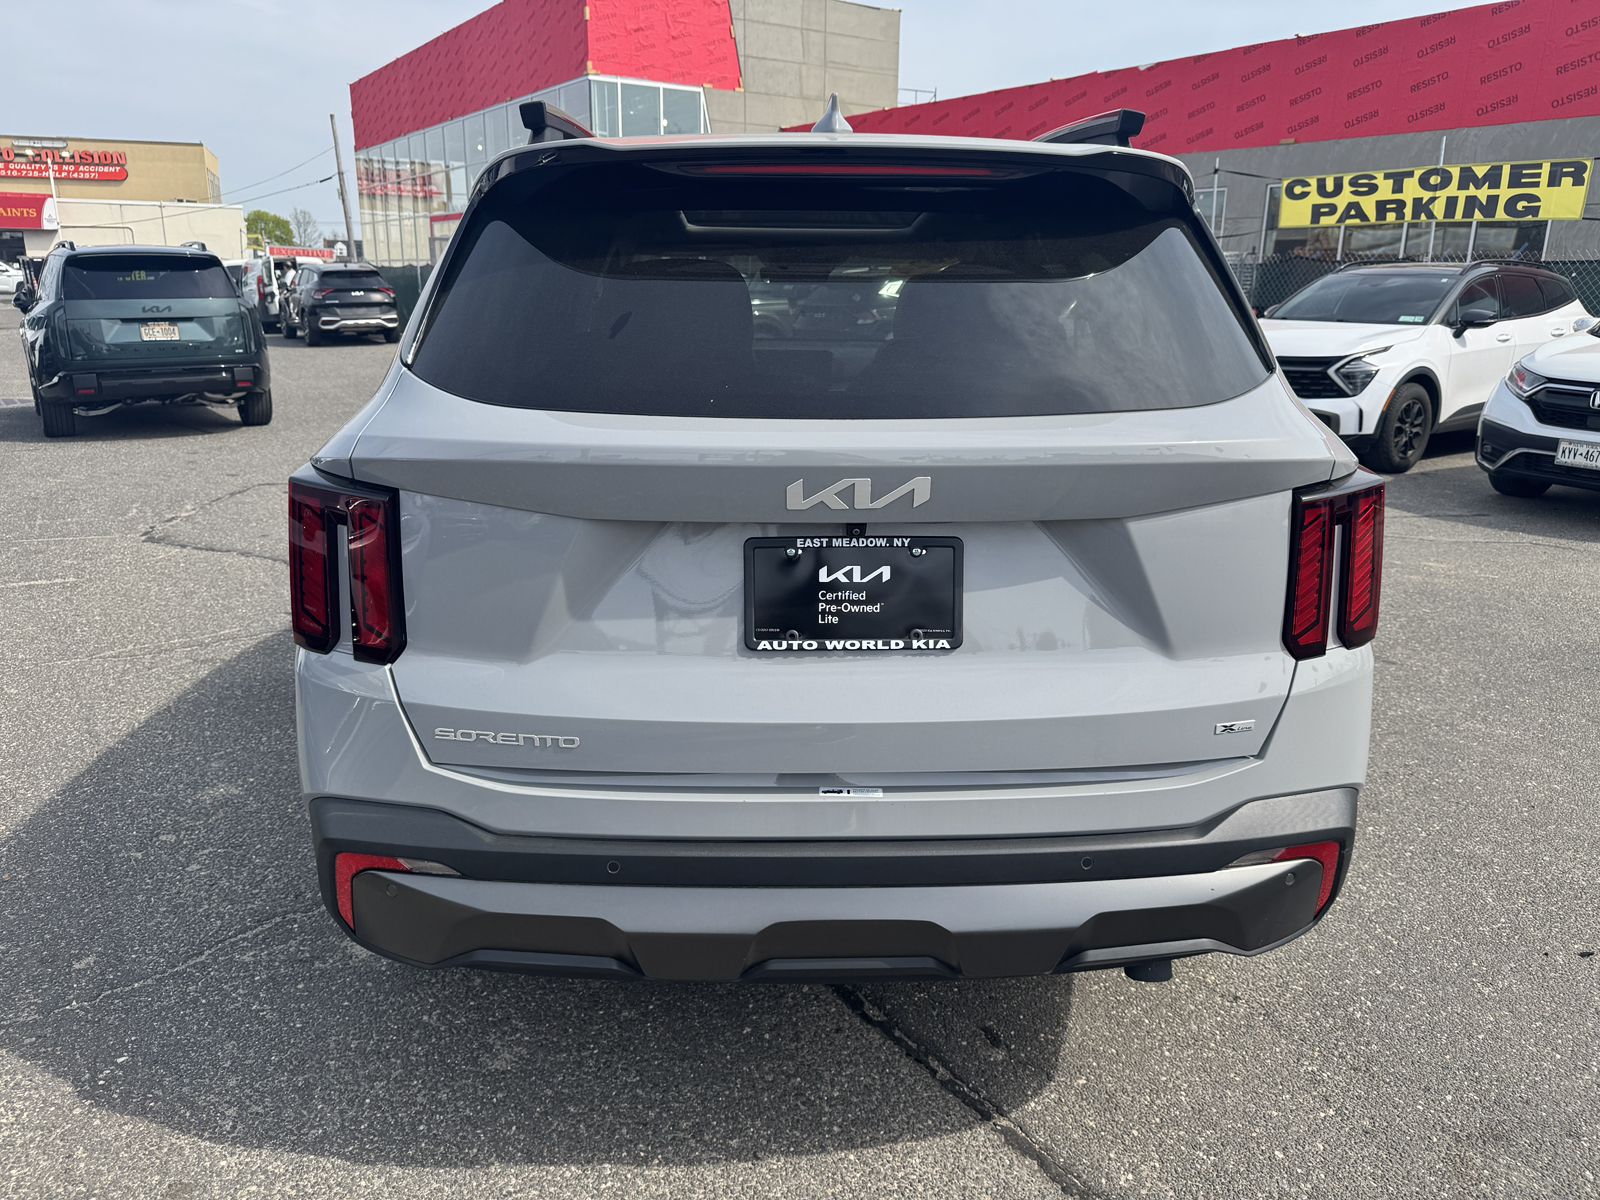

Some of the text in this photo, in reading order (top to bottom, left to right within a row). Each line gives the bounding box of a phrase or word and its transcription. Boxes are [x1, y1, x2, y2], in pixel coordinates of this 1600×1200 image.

[1491, 0, 1526, 16] RESIS
[1420, 10, 1459, 28] RESIS
[1565, 16, 1600, 37] SISTO
[1356, 22, 1390, 38] RESIS
[1487, 24, 1531, 49] RESISTO
[1352, 45, 1389, 67] RESISTO
[1417, 35, 1456, 59] RESISTO
[1241, 63, 1271, 83] RESISTO
[1295, 54, 1327, 76] RESISTO
[1480, 62, 1523, 85] RESISTO
[1192, 72, 1220, 91] RESISTO
[1347, 80, 1382, 100] RESISTO
[1410, 71, 1449, 93] RESISTO
[1236, 94, 1266, 113] RESISTO
[1289, 87, 1322, 107] RESISTO
[1477, 94, 1519, 116] RESISTO
[1551, 86, 1598, 108] RESISTO
[1188, 102, 1215, 120] RESISTO
[1344, 109, 1380, 130] RESISTO
[1407, 102, 1446, 123] RESISTO
[1234, 121, 1264, 140] RESISTO
[1287, 115, 1320, 135] RESISTO
[1186, 128, 1214, 145] RESISTO
[1285, 160, 1589, 201] CUSTOMER
[1310, 193, 1542, 225] PARKING
[274, 247, 331, 258] EXECUTIVE
[142, 306, 172, 314] KIA
[786, 476, 932, 510] KIA
[796, 538, 828, 548] EAST
[894, 538, 911, 548] NY
[818, 565, 891, 583] KIA
[818, 590, 866, 601] Certified
[818, 614, 839, 624] Lite
[756, 640, 951, 650] AUTO WORLD KIA
[434, 727, 581, 748] SORENTO
